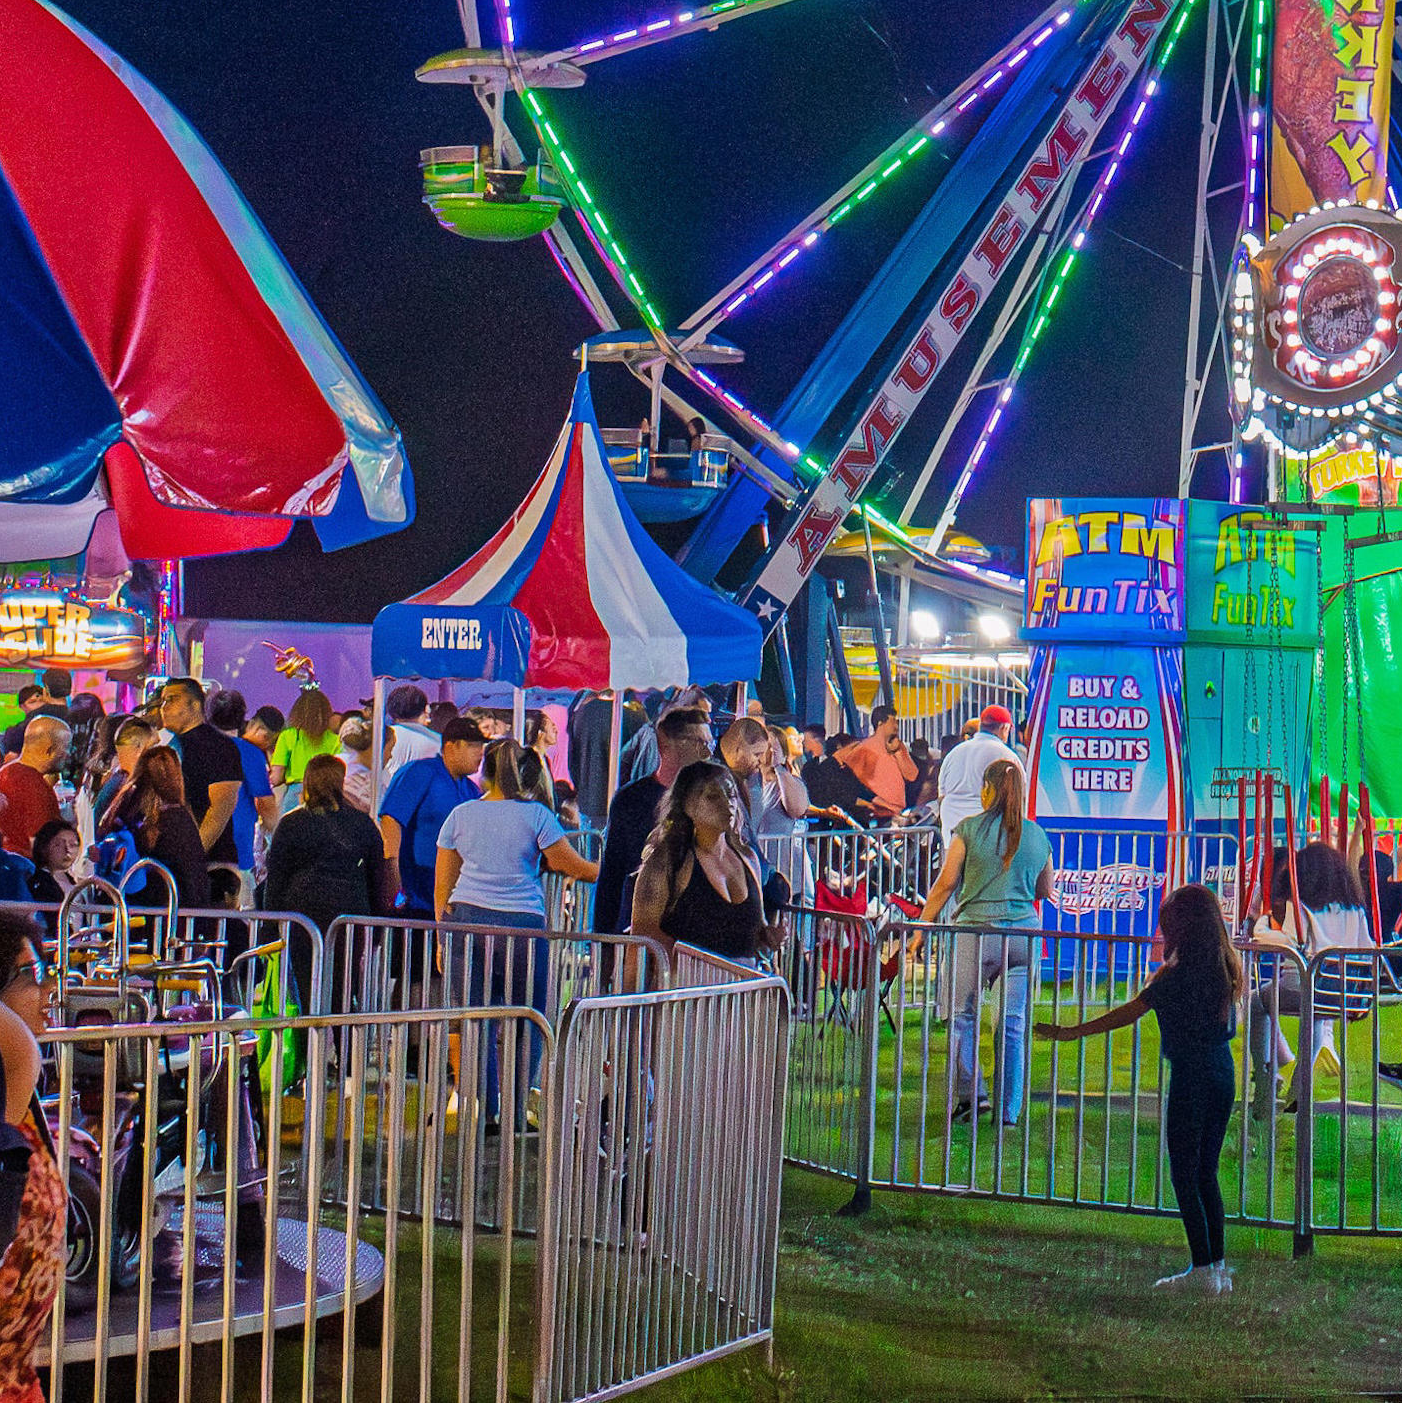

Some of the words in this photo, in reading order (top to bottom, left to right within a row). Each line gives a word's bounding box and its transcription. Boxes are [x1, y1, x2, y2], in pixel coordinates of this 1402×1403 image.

[1310, 447, 1391, 498] TURKEY
[1036, 511, 1176, 568] ATM
[1214, 512, 1296, 579] ATM
[3, 627, 94, 664] SLIDE
[421, 618, 483, 650] ENTER
[1068, 675, 1117, 698] BUY
[1120, 675, 1142, 700] &
[1058, 705, 1150, 730] RELOAD
[1056, 736, 1150, 761] CREDITS
[1073, 767, 1133, 792] HERE
[1054, 869, 1166, 888] MUSEMENTS
